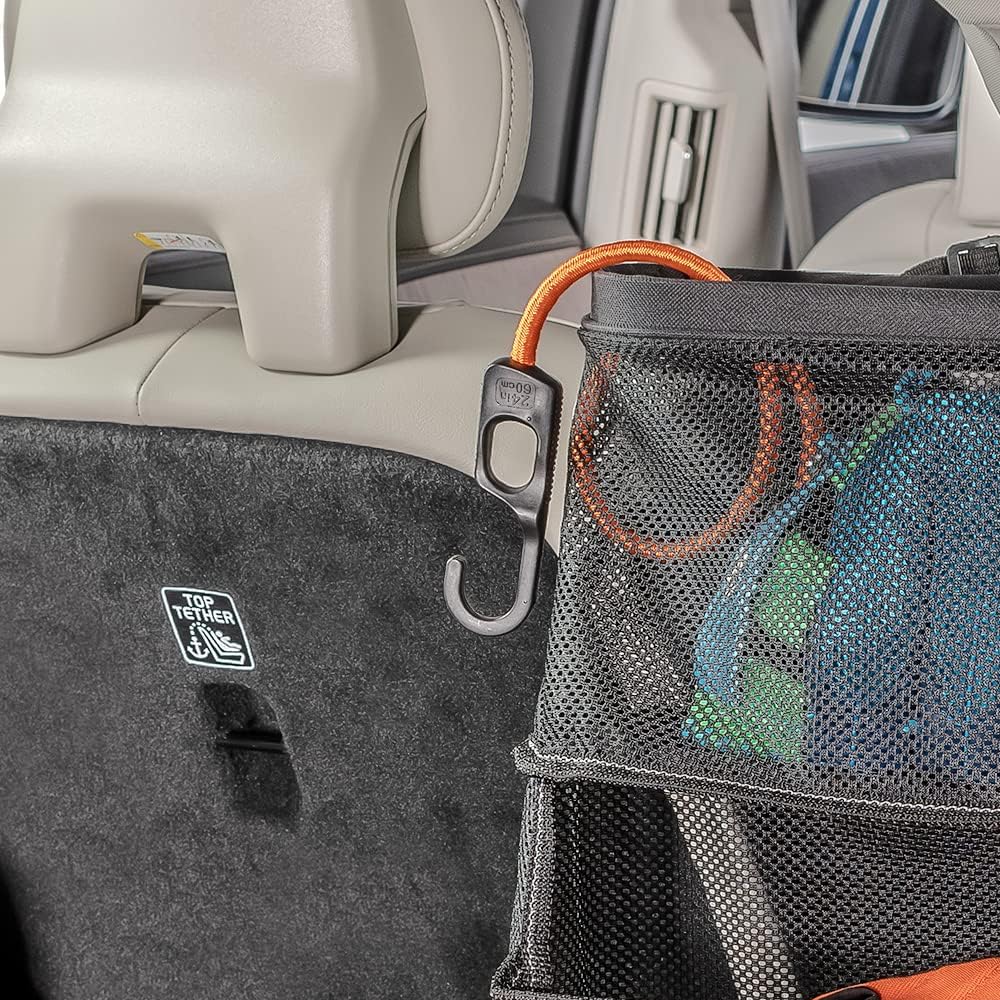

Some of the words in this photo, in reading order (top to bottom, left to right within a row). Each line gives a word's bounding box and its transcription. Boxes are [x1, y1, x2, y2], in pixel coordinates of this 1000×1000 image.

[500, 380, 532, 395] 60cm
[182, 593, 215, 609] TOP
[172, 605, 236, 625] TETHER
